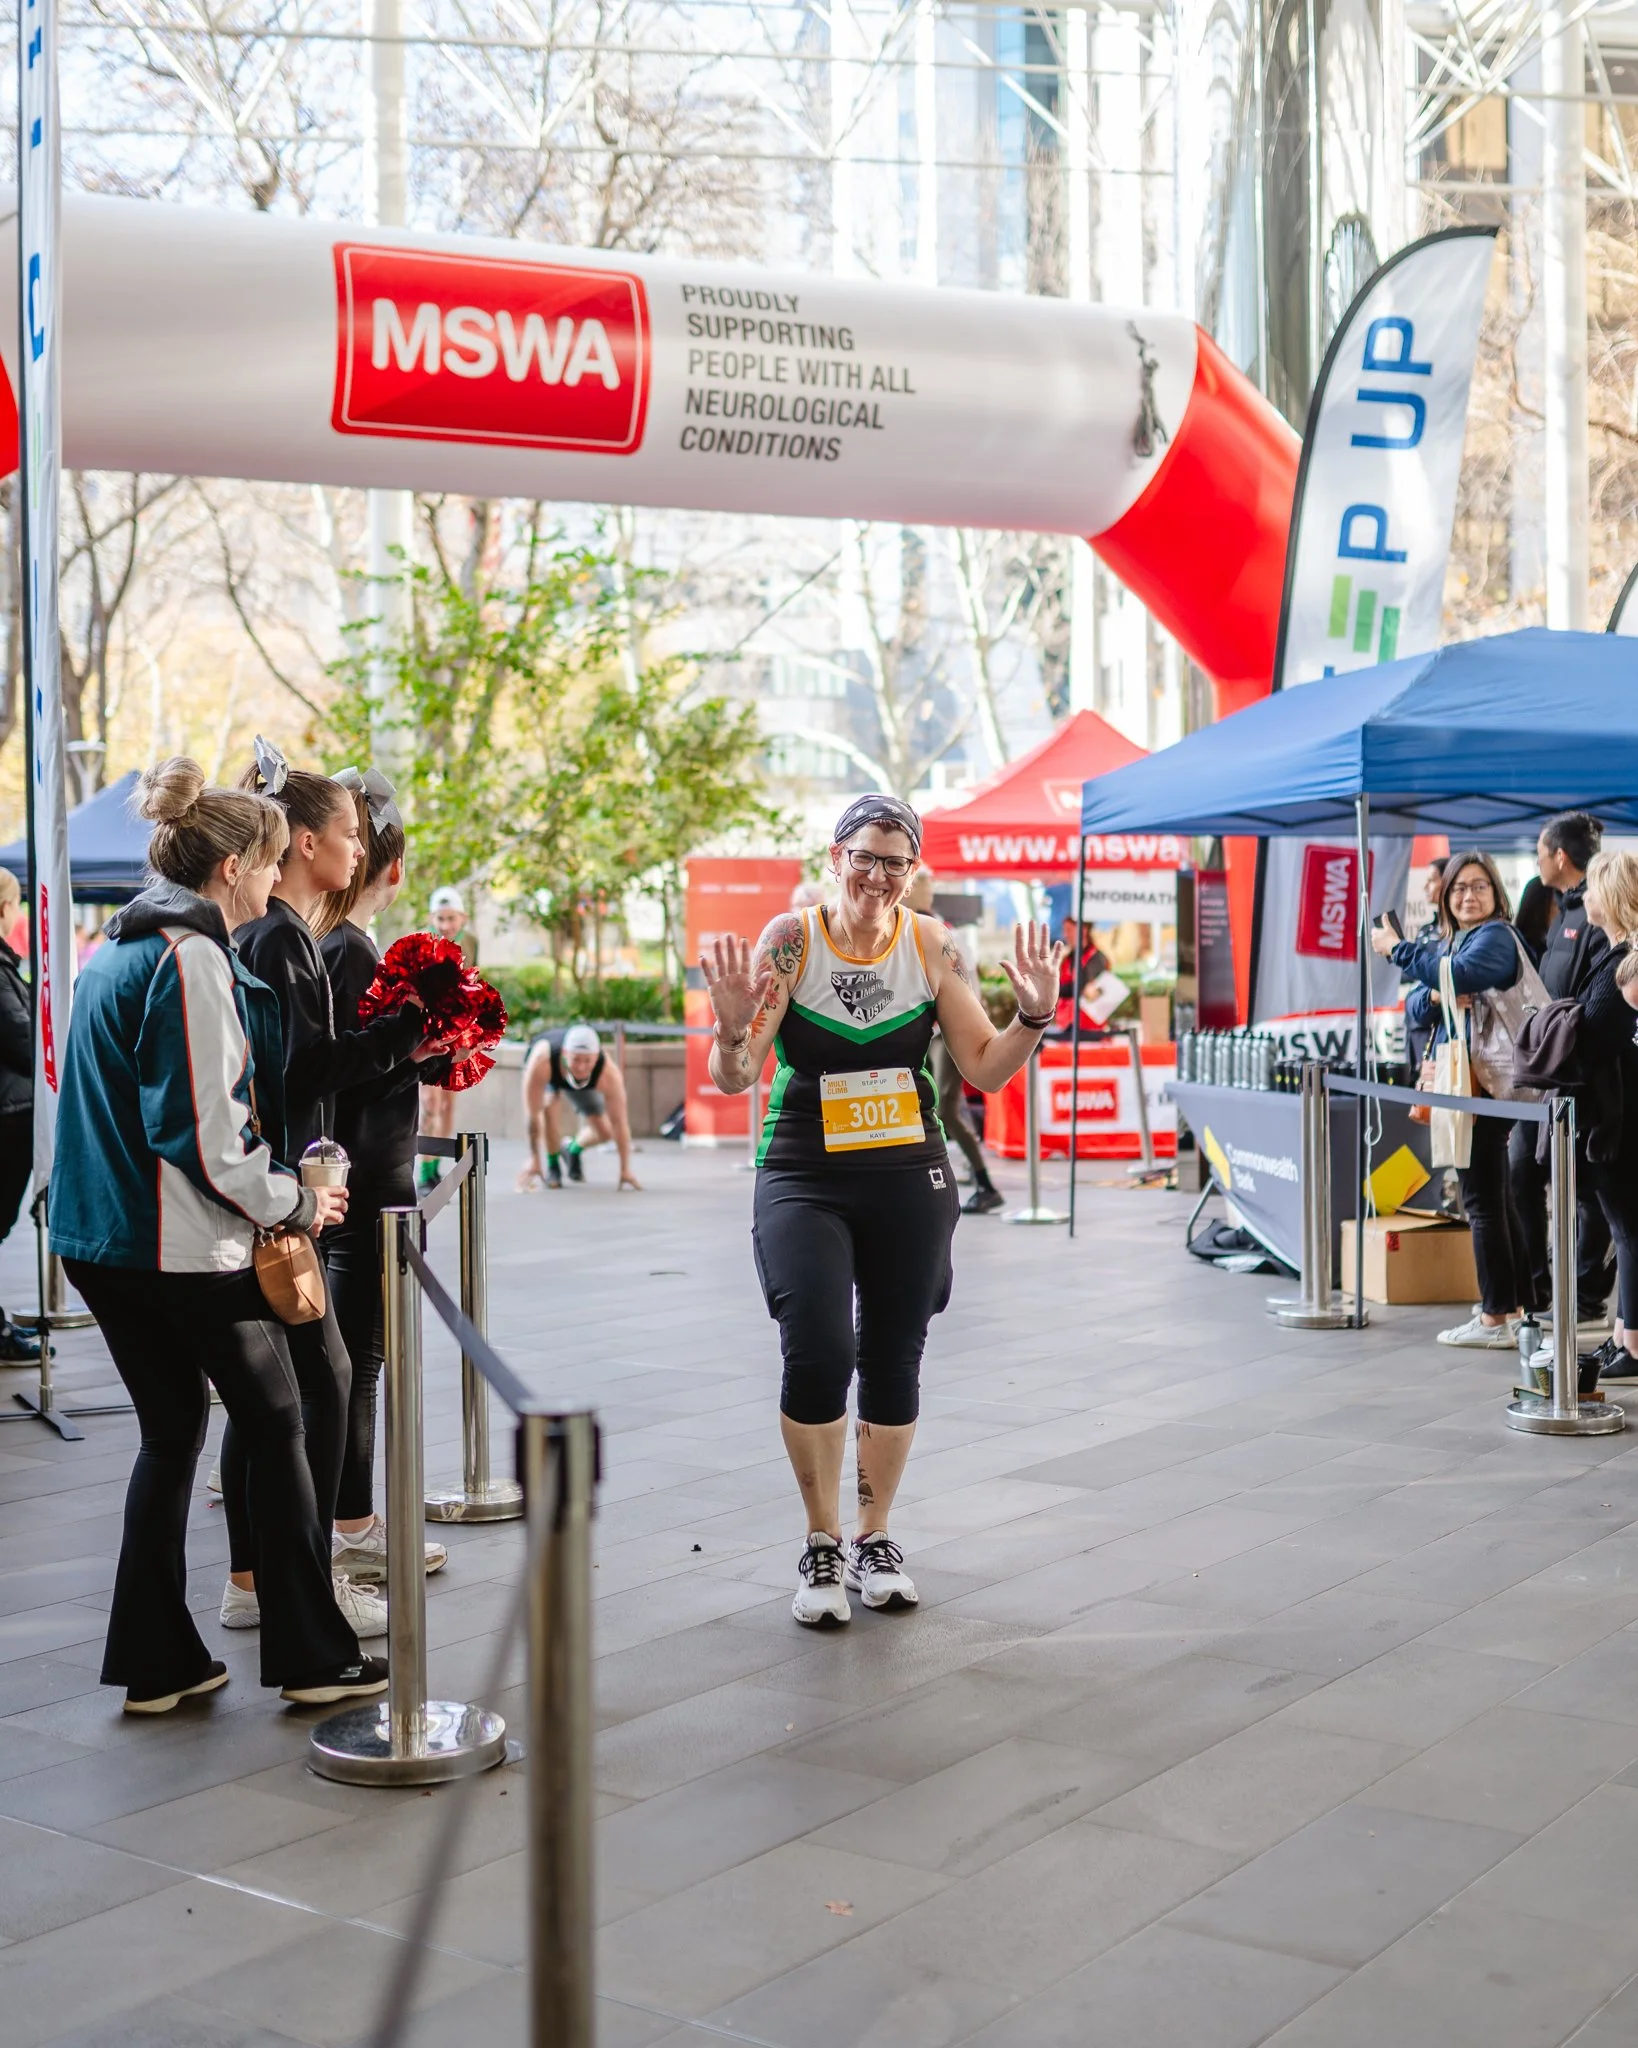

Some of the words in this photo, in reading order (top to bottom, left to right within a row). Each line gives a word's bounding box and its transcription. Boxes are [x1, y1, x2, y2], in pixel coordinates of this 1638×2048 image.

[681, 284, 799, 313] PROUDLY
[371, 297, 621, 391] MSWA
[687, 312, 855, 351] SUPPORTING
[688, 348, 788, 383] PEOPLE
[797, 357, 862, 390] WITH
[870, 365, 916, 394] ALL
[1351, 315, 1433, 450] UP
[685, 387, 885, 430] NEUROLOGICAL
[680, 425, 842, 462] CONDITIONS
[1083, 890, 1177, 905] INFORMATI
[1318, 856, 1352, 949] MSWA
[831, 972, 876, 986] STAIR
[827, 1080, 847, 1088] MULTI
[827, 1087, 848, 1095] CLIMB
[849, 1098, 901, 1128] 3012
[1225, 1142, 1299, 1183] Commonwealth
